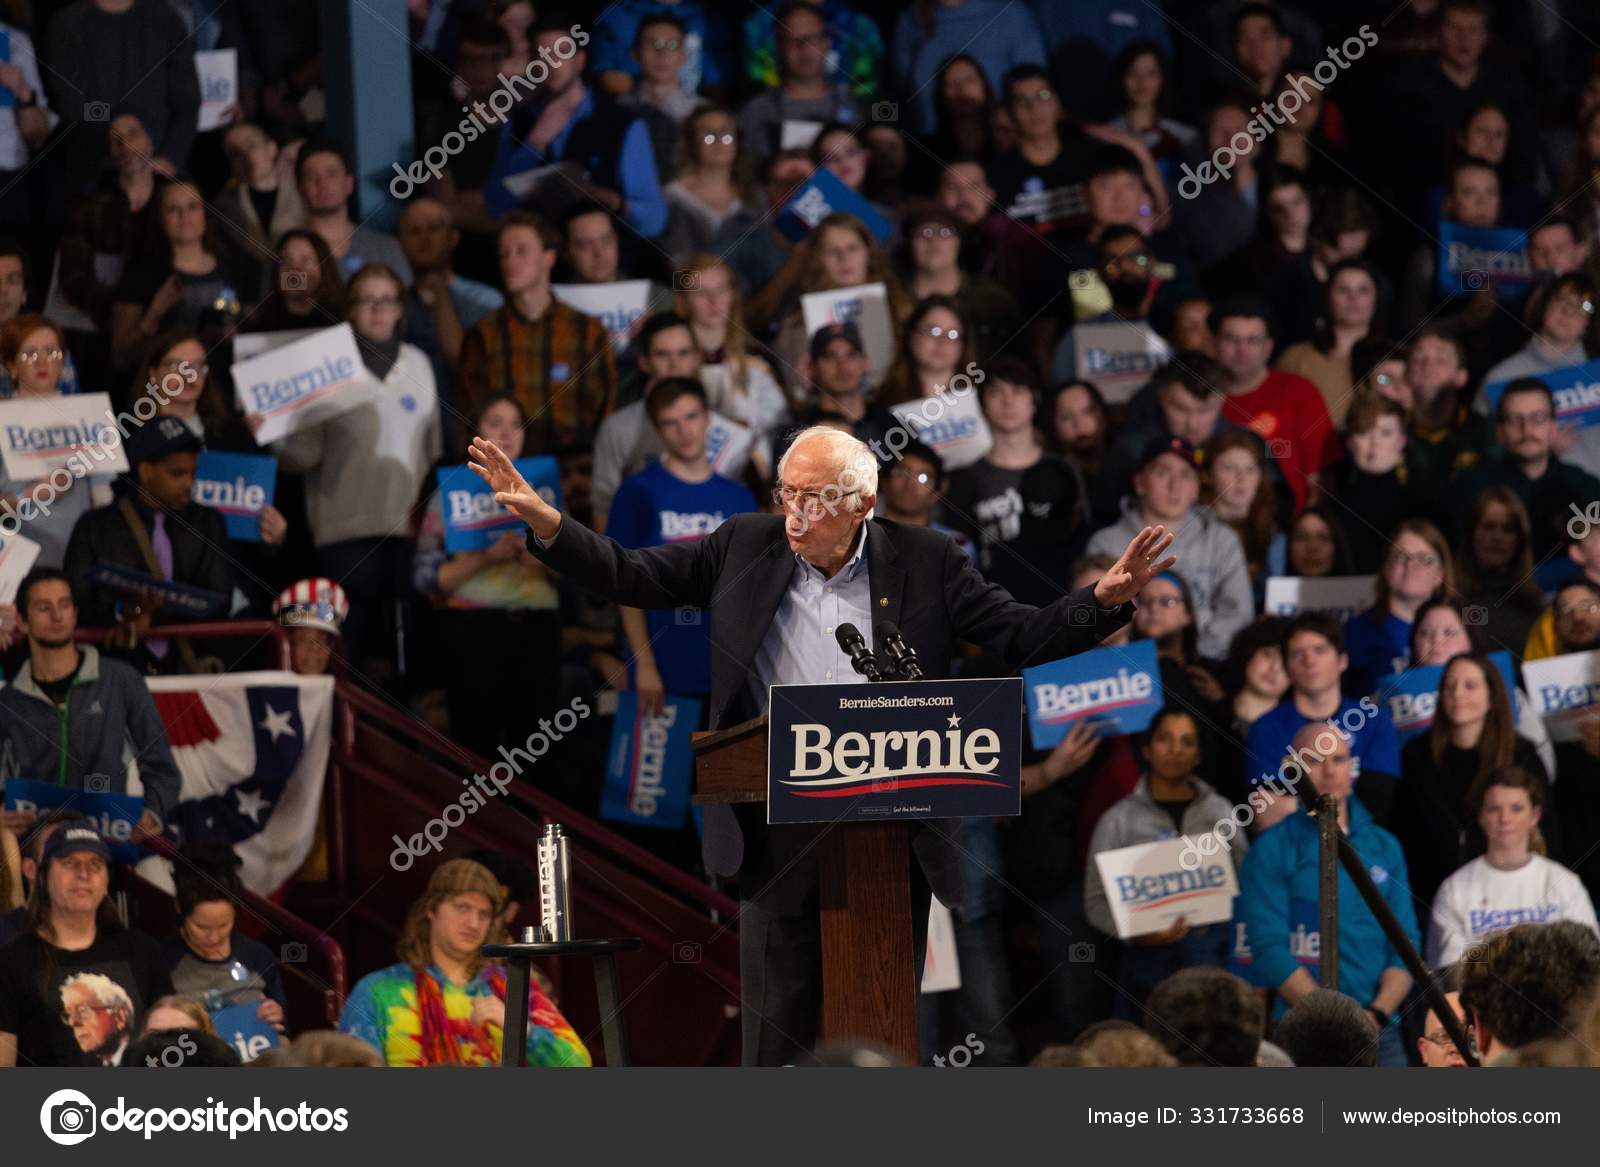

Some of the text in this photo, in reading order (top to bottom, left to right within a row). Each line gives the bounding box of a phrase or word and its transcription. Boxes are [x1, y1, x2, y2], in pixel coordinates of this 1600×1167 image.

[251, 355, 353, 410] Bernie
[192, 476, 265, 511] rnie
[839, 695, 954, 710] BernieSanders.com
[1034, 667, 1152, 713] Bernie
[789, 712, 1001, 777] Bernie
[1115, 863, 1225, 902] Bernie
